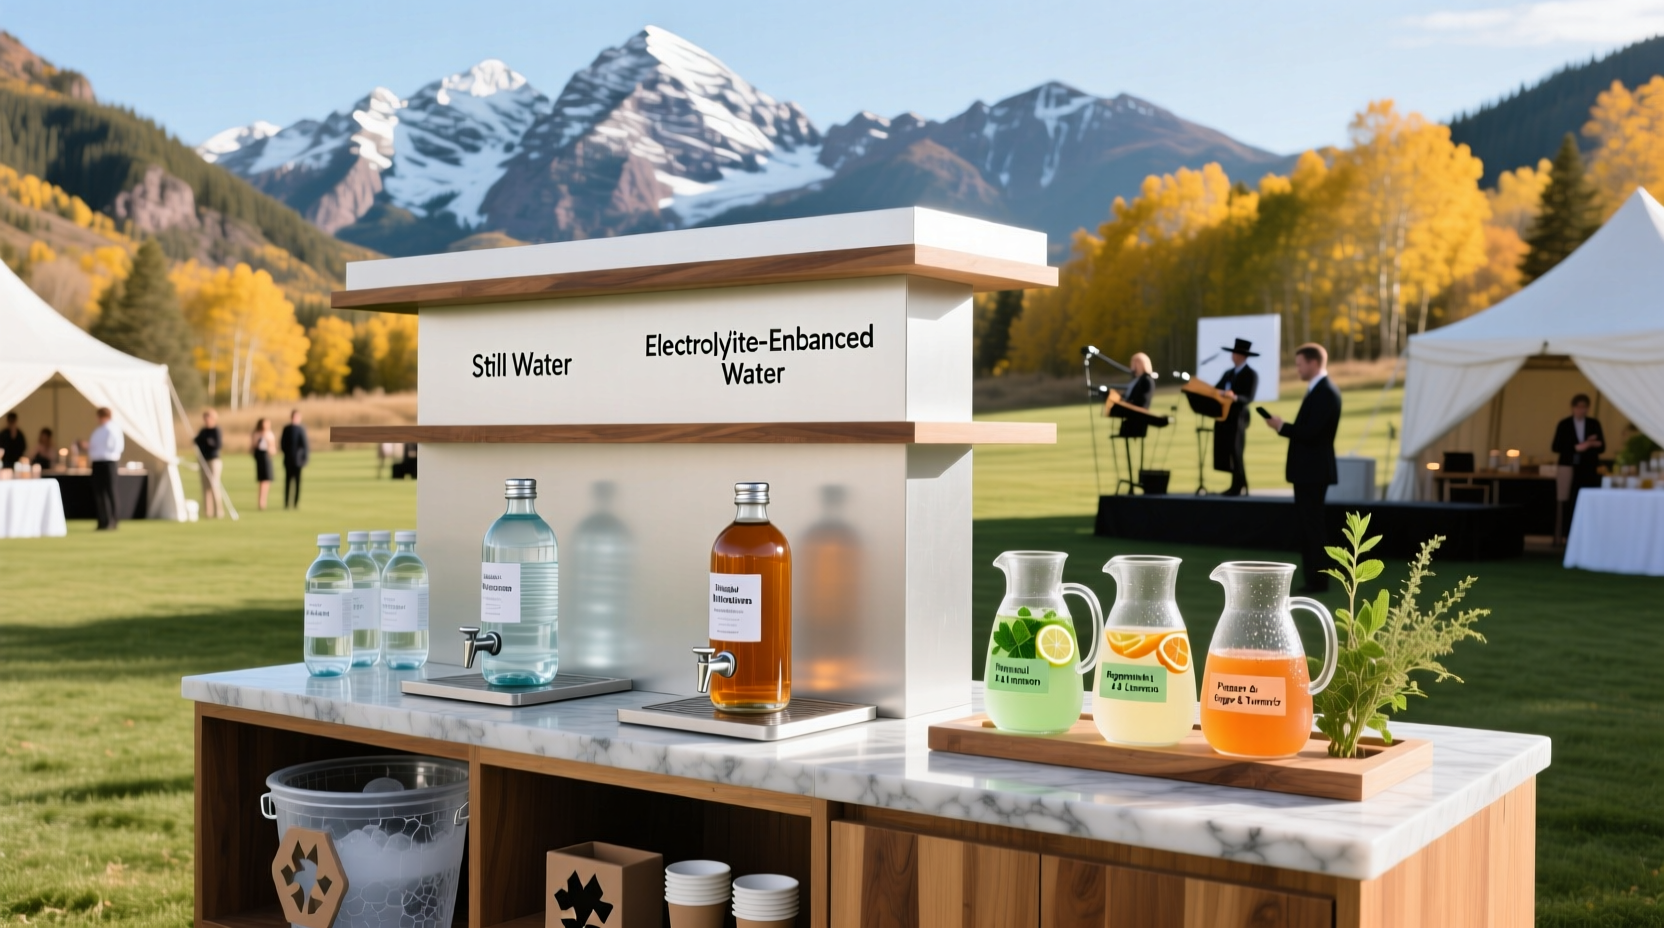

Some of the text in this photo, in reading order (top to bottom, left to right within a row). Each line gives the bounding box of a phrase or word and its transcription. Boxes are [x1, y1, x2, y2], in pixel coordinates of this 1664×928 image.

[472, 351, 573, 378] Still Water
[721, 361, 786, 386] Water
